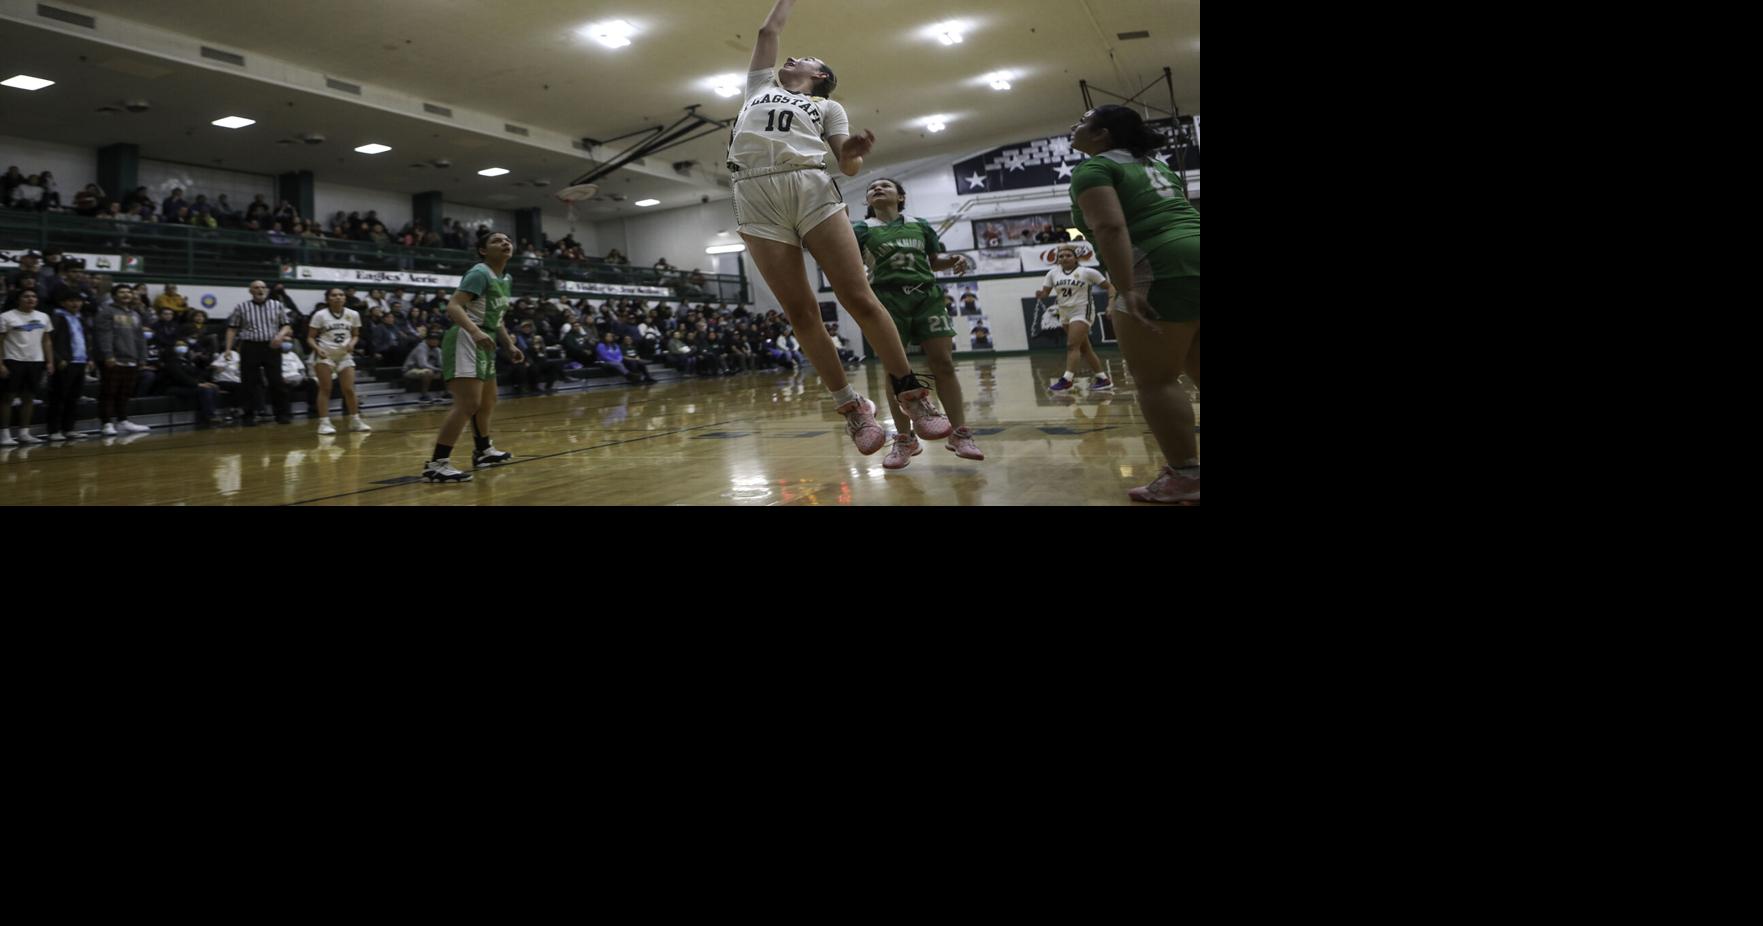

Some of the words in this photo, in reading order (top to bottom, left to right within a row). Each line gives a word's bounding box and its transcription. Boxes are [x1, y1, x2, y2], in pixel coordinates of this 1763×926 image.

[765, 109, 794, 132] 10
[1061, 287, 1072, 297] 24
[929, 316, 951, 332] 21
